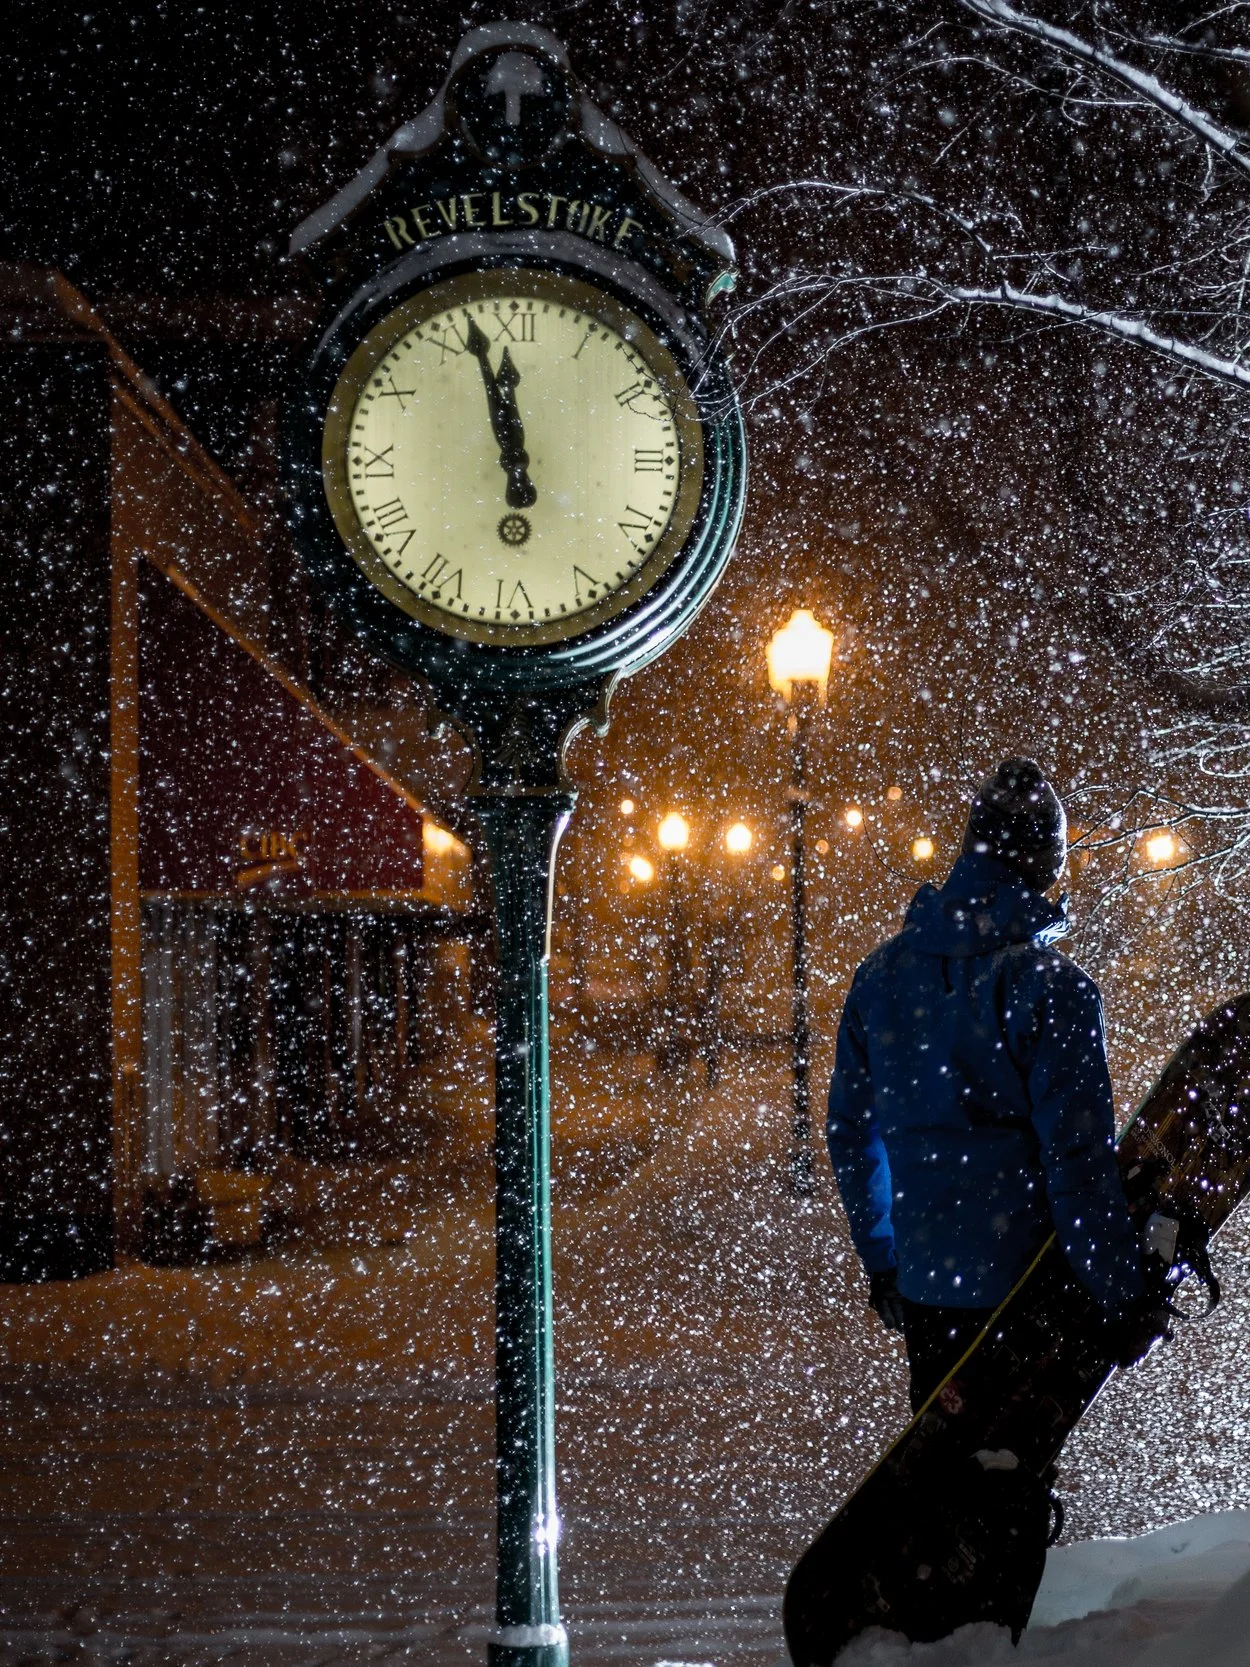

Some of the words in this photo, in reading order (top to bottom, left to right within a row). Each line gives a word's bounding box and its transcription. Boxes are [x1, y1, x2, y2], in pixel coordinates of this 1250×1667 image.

[384, 191, 643, 249] REVELSTOKE
[491, 312, 536, 342] XII
[378, 376, 417, 413] X
[614, 382, 646, 407] II
[364, 443, 394, 479] IX
[634, 449, 665, 473] III
[373, 497, 416, 556] VIII
[617, 505, 654, 551] IV
[421, 553, 463, 600] VII
[495, 579, 534, 609] VI
[573, 564, 601, 597] V
